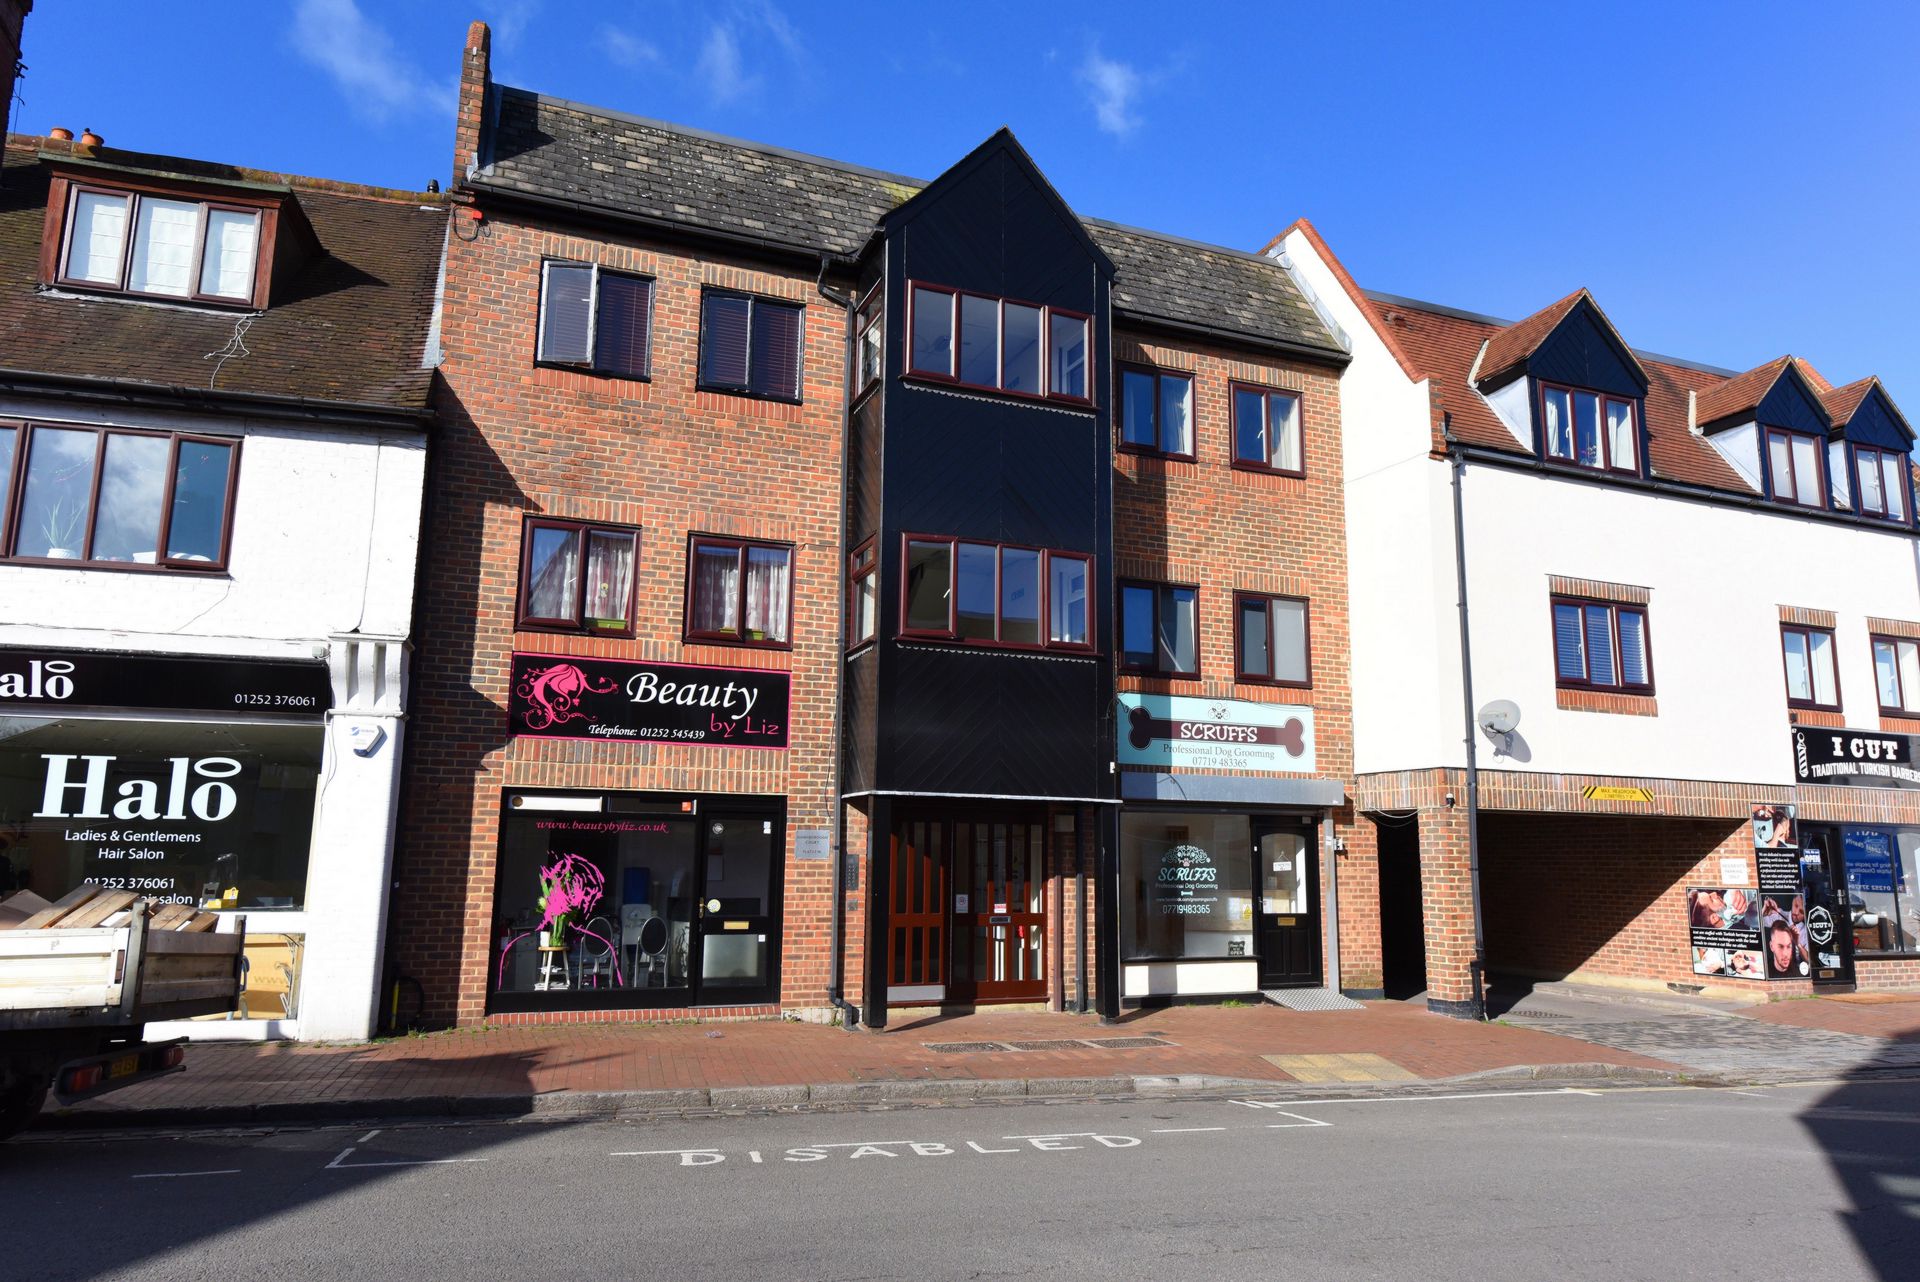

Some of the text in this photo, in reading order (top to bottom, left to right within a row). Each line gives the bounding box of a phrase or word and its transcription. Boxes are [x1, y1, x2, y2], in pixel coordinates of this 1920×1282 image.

[234, 693, 316, 706] 01252 376061
[626, 672, 758, 720] Beauty
[588, 724, 705, 740] Telephone: 01252 545439
[710, 713, 779, 738] by Liz
[1180, 723, 1258, 742] SCRUFFS
[1162, 744, 1275, 760] Professional Dog Grooming
[1831, 737, 1898, 760] I CUT
[1192, 757, 1248, 767] 07719 483365
[1811, 762, 1858, 778] TRADITIONAL
[1859, 762, 1891, 777] TURKISH
[32, 754, 243, 821] Halo
[535, 820, 670, 834] www.beautybyliz.co.uk
[64, 829, 201, 842] Ladies & Gentlemens
[98, 848, 164, 860] Hair Salon
[1158, 867, 1217, 881] SCRUFFS
[84, 877, 175, 889] 01252 376061
[159, 893, 193, 905] salon
[679, 1135, 1142, 1166] DISABLED
